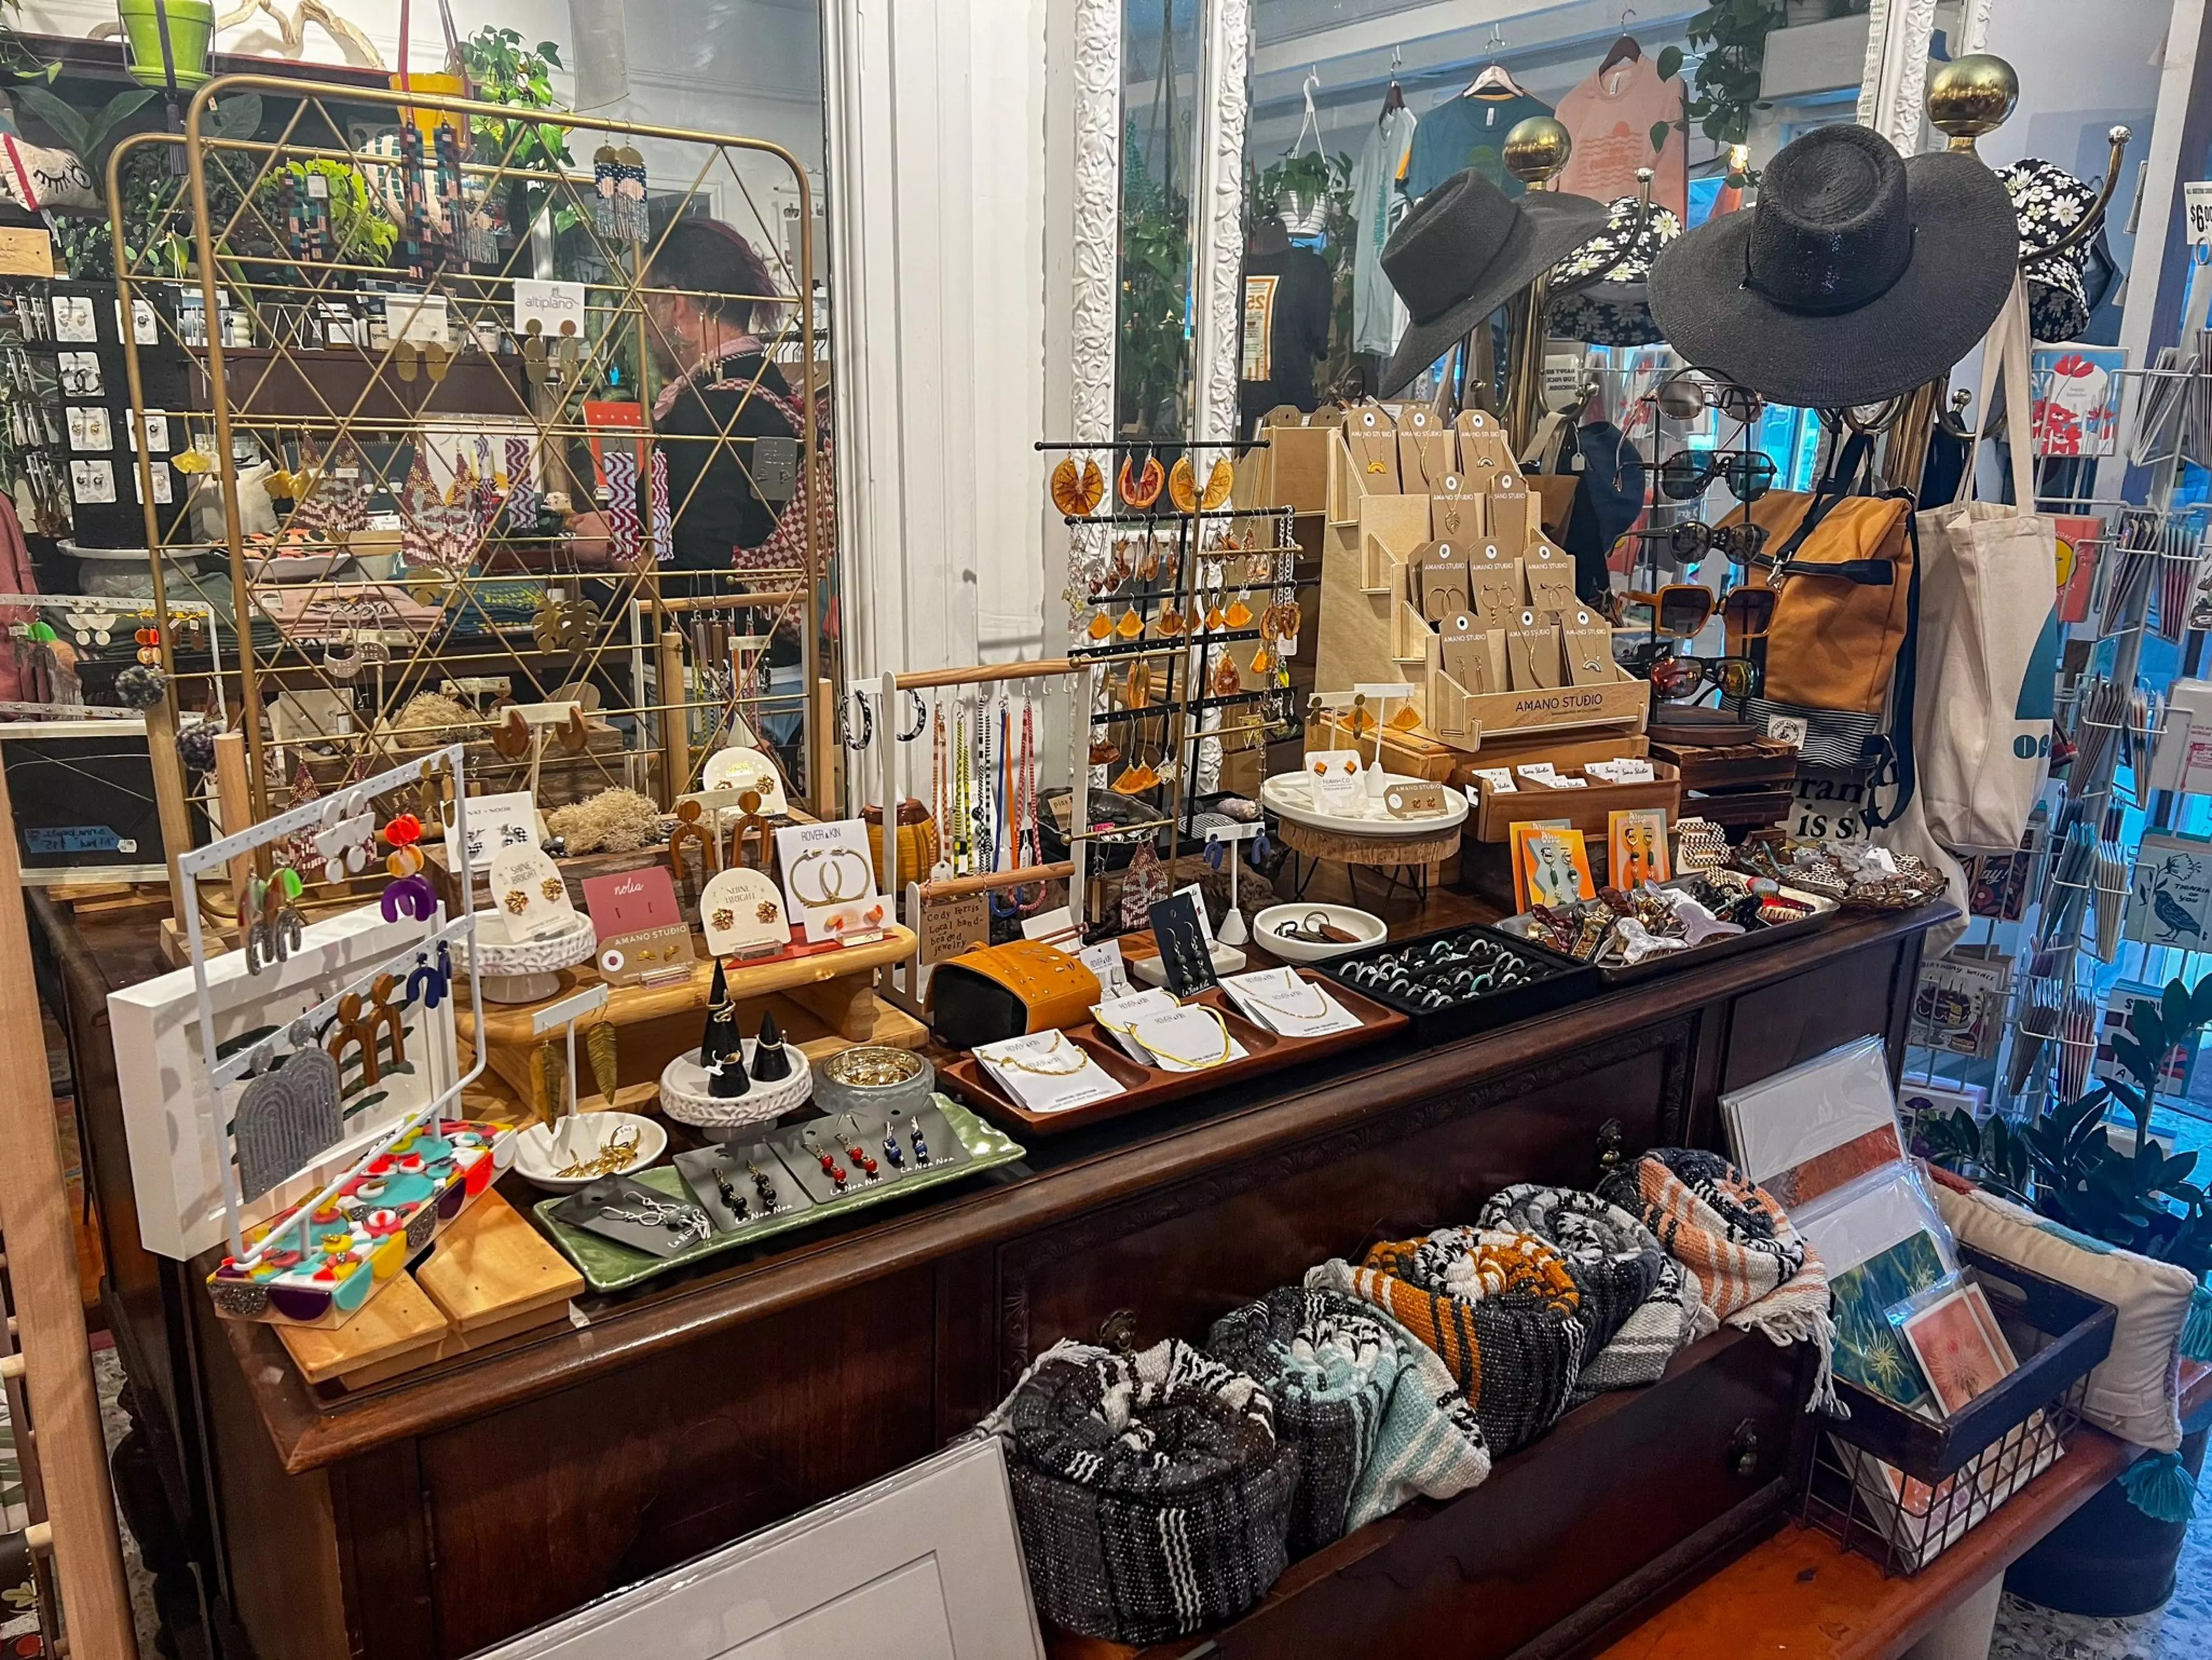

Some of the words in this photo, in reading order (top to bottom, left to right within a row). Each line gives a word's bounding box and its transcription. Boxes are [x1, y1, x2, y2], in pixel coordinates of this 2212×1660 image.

[525, 296, 573, 311] altiplano
[1515, 698, 1559, 712] AMANO
[1562, 694, 1603, 708] STUDIO
[1796, 804, 1827, 837] is
[801, 830, 824, 842] ROVER
[830, 827, 842, 837] KIN
[510, 861, 531, 875] SHINE
[511, 869, 537, 885] BRIGHT
[613, 878, 643, 895] nolia
[726, 884, 750, 894] SHINE
[725, 893, 755, 903] BRIGHT
[2179, 895, 2199, 903] YOU
[927, 911, 950, 922] Cody
[955, 905, 979, 914] Ferris
[929, 921, 952, 934] Local
[957, 917, 983, 927] hand-
[615, 933, 650, 946] AMANO
[652, 925, 687, 939] STUDIO
[930, 932, 961, 946] beaded
[934, 940, 967, 956] jewelry
[1920, 961, 1963, 973] BIRTHDAY
[2115, 1068, 2126, 1078] A
[915, 1162, 934, 1170] Noa
[936, 1156, 955, 1165] Noa
[843, 1183, 863, 1193] Noa
[864, 1177, 884, 1186] Noa
[735, 1216, 748, 1224] La
[751, 1211, 771, 1221] Noa
[773, 1204, 793, 1215] Noa
